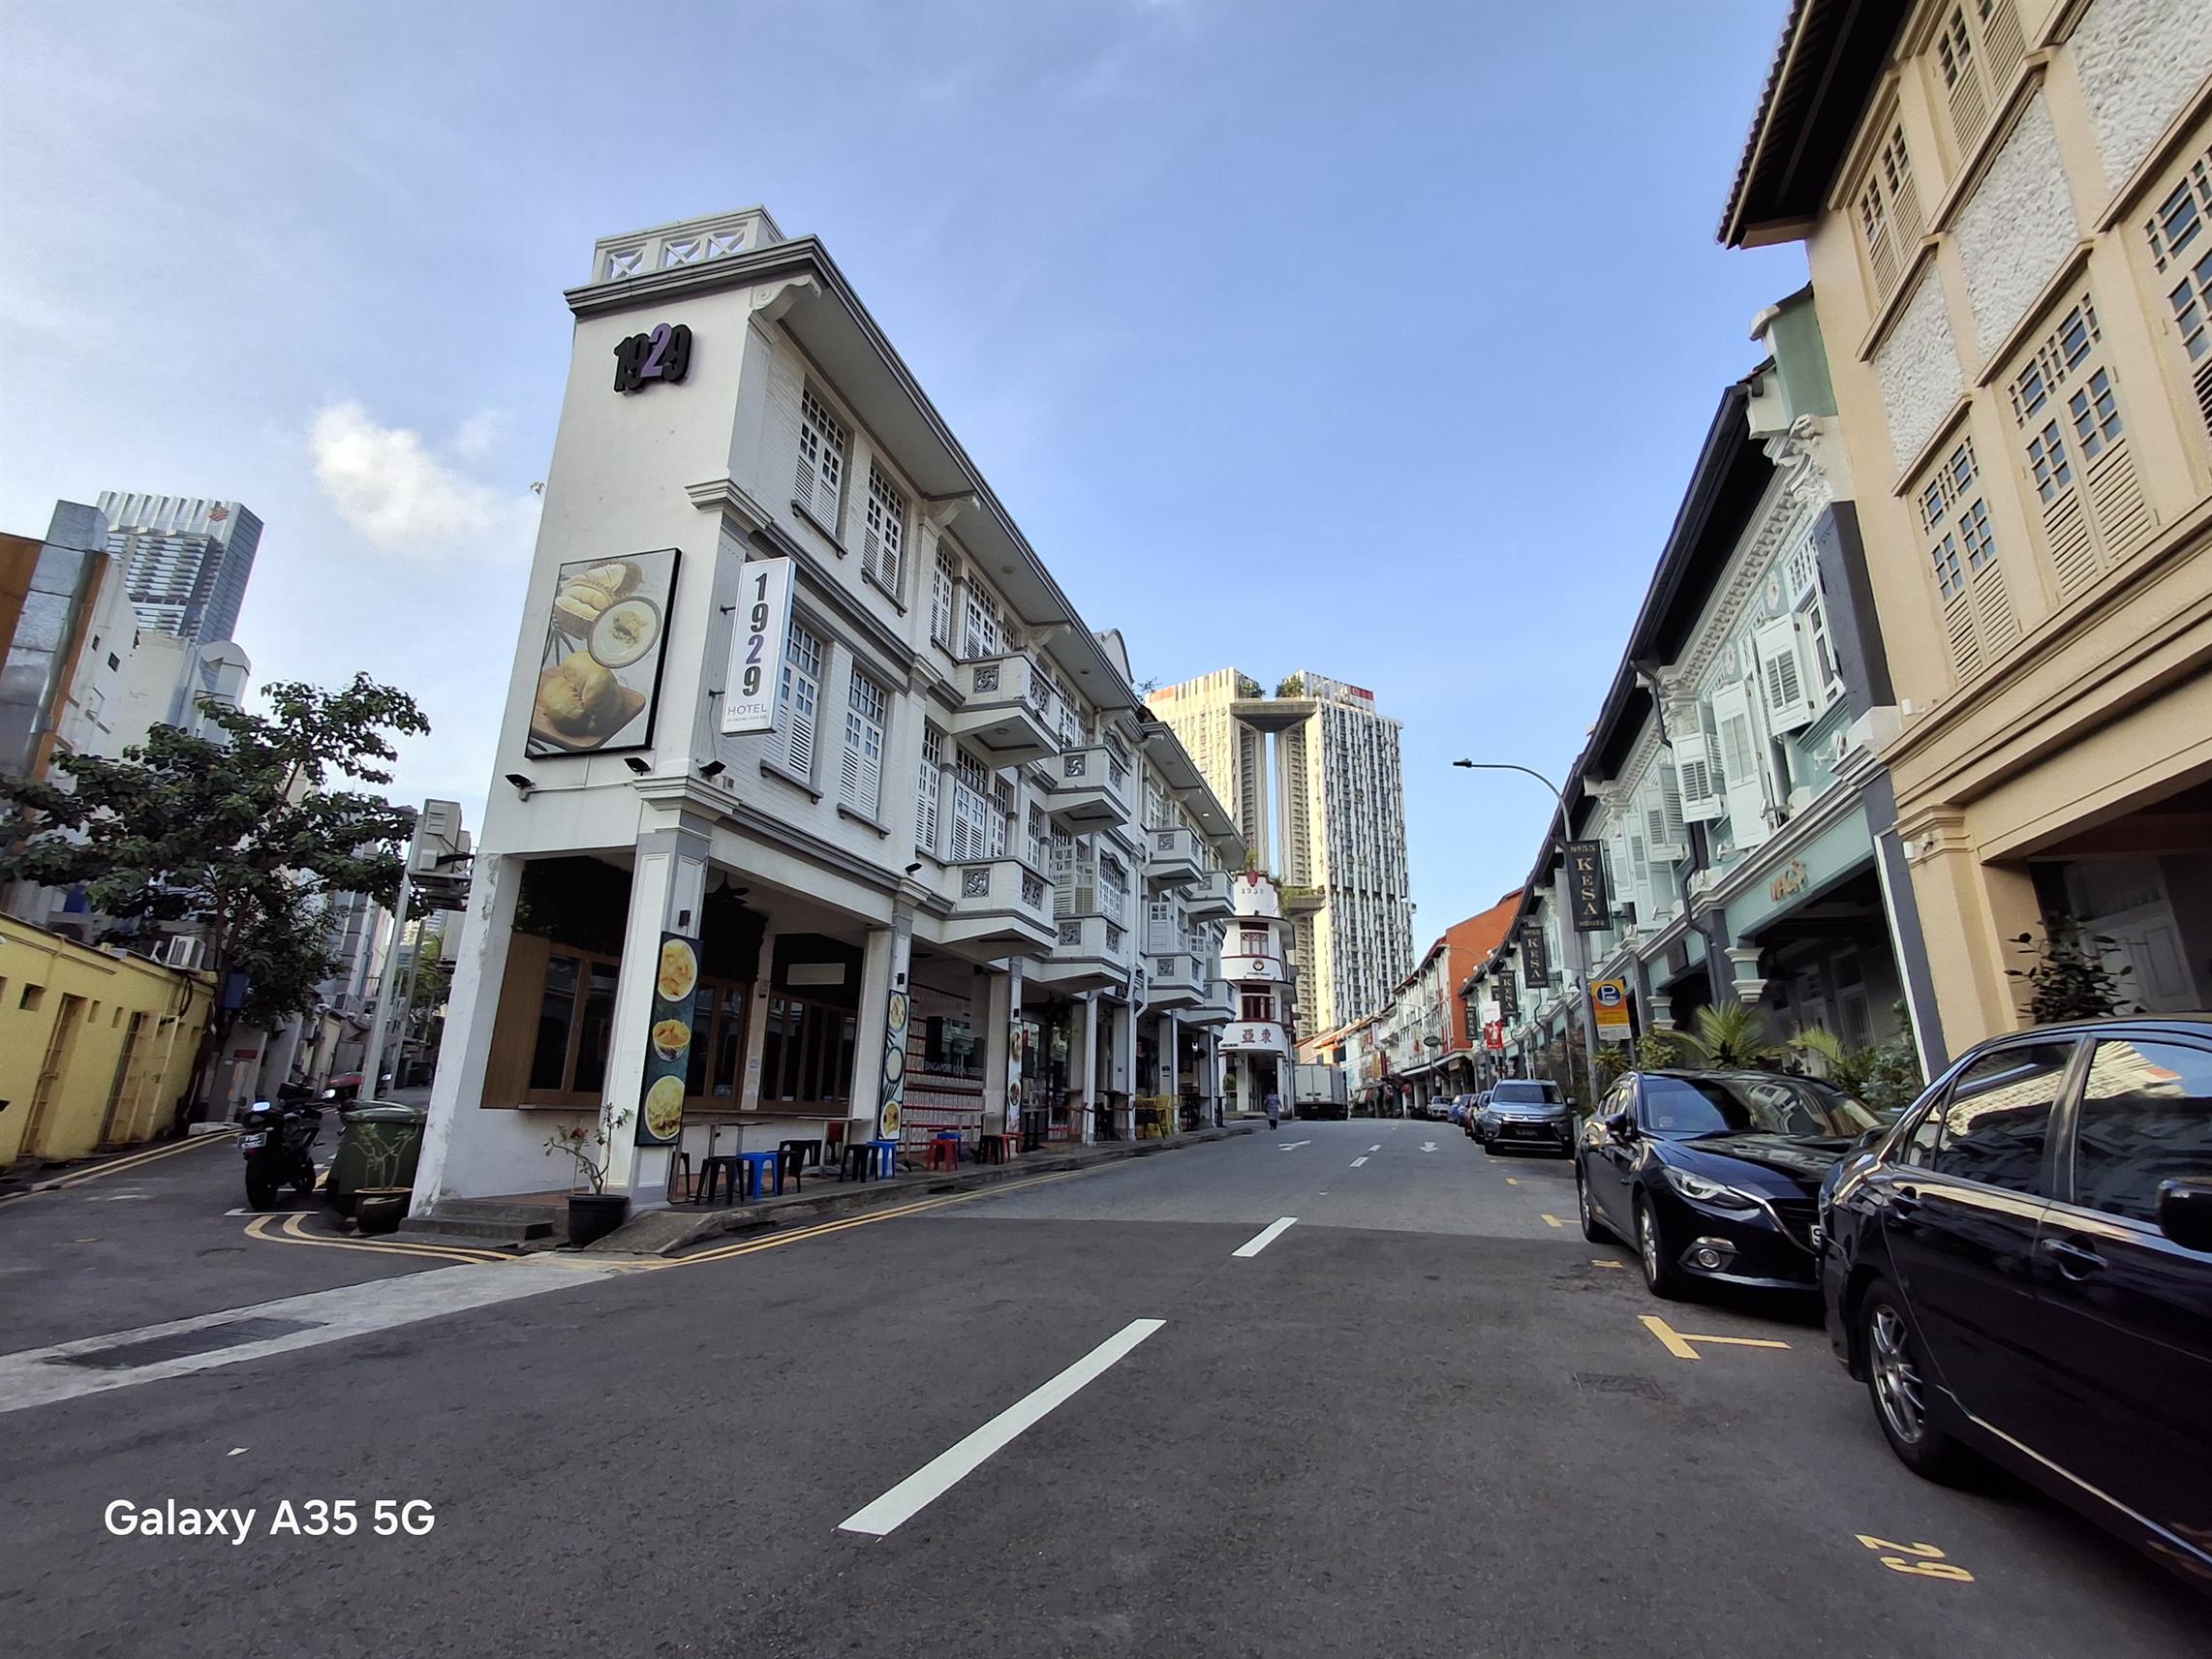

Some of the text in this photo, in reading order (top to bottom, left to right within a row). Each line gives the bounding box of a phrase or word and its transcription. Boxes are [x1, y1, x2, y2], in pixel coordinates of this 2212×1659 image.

[614, 323, 692, 392] 1929
[742, 572, 769, 697] 1929
[727, 703, 768, 716] HOTEL
[1575, 857, 1598, 915] KESA
[1526, 937, 1542, 978] KESA
